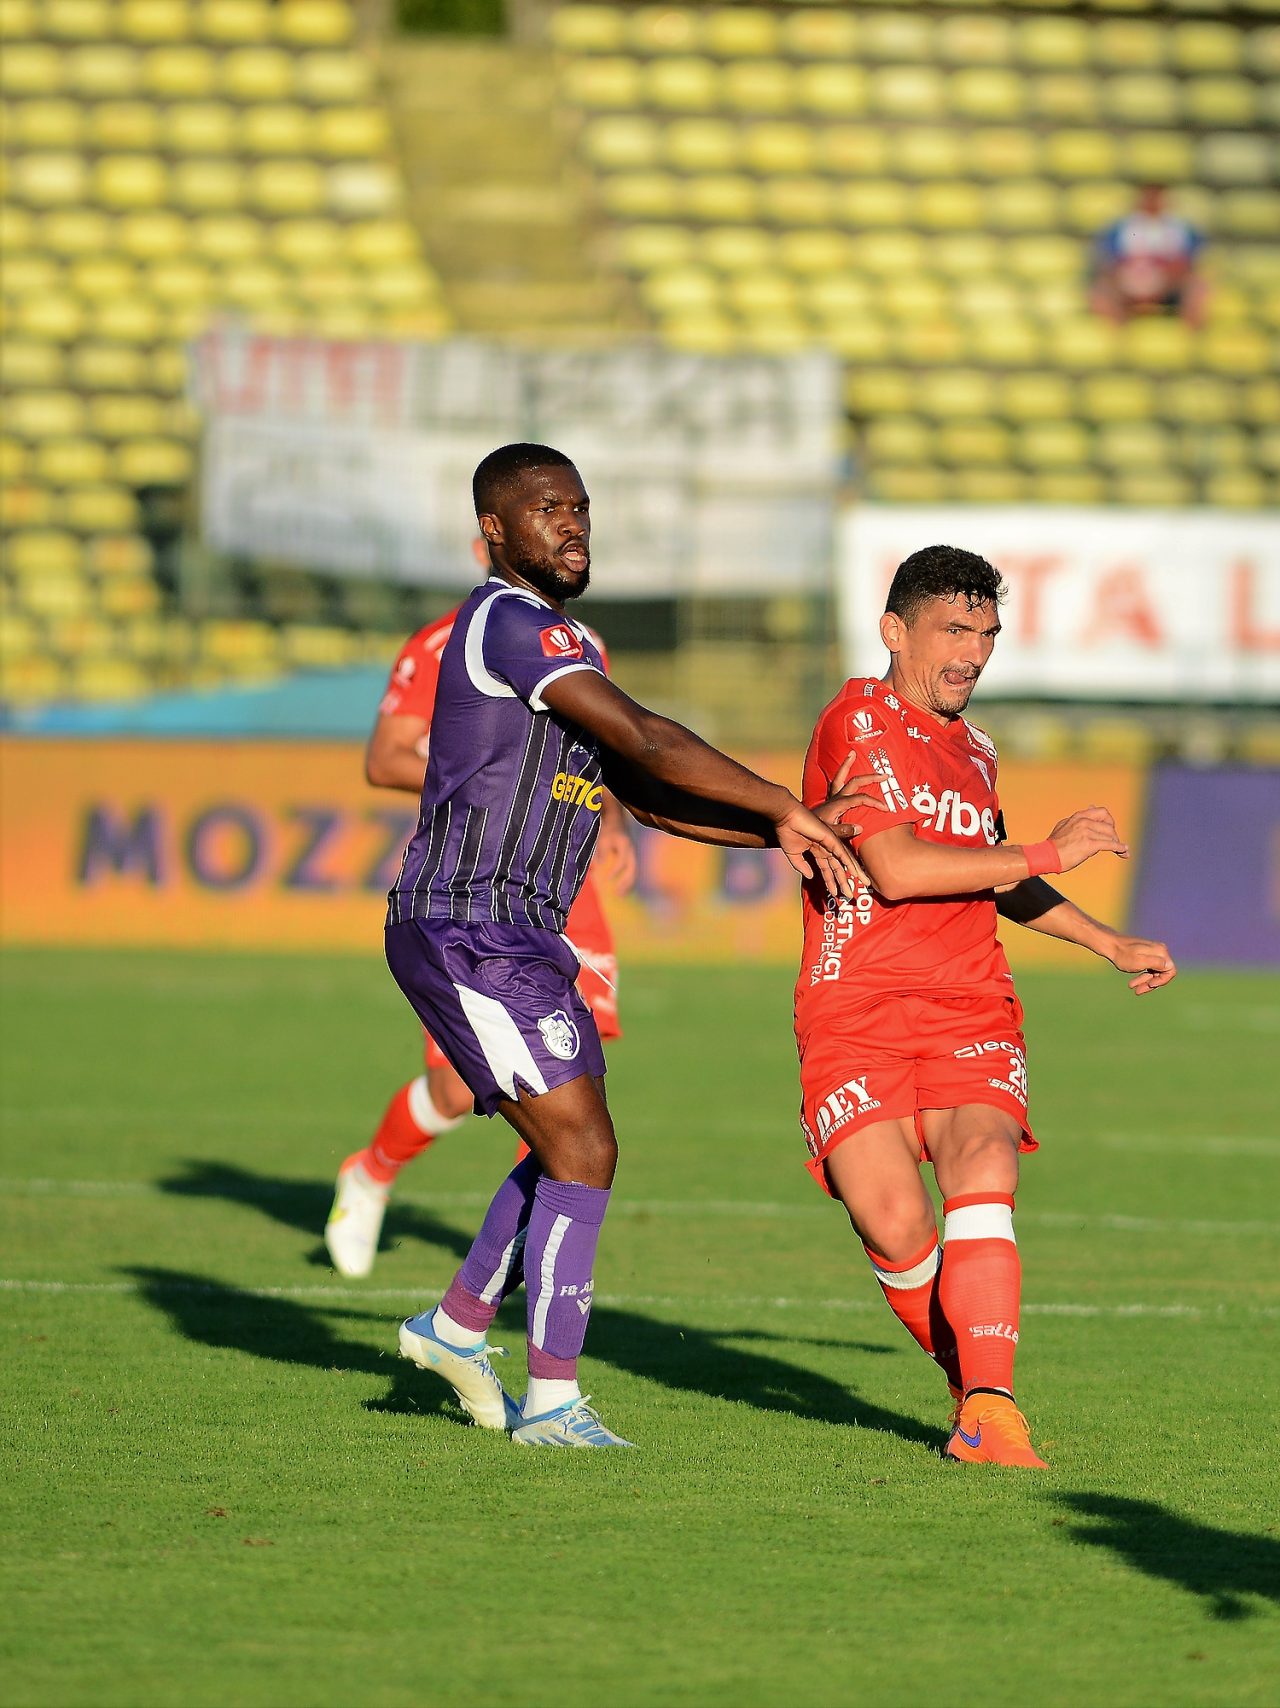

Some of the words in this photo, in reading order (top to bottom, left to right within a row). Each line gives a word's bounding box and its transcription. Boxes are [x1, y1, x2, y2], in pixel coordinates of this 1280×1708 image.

[880, 550, 1162, 654] TA
[552, 772, 604, 812] GETIC
[911, 789, 997, 846] efbe
[816, 1075, 873, 1142] DEY
[857, 1099, 882, 1115] ARAD
